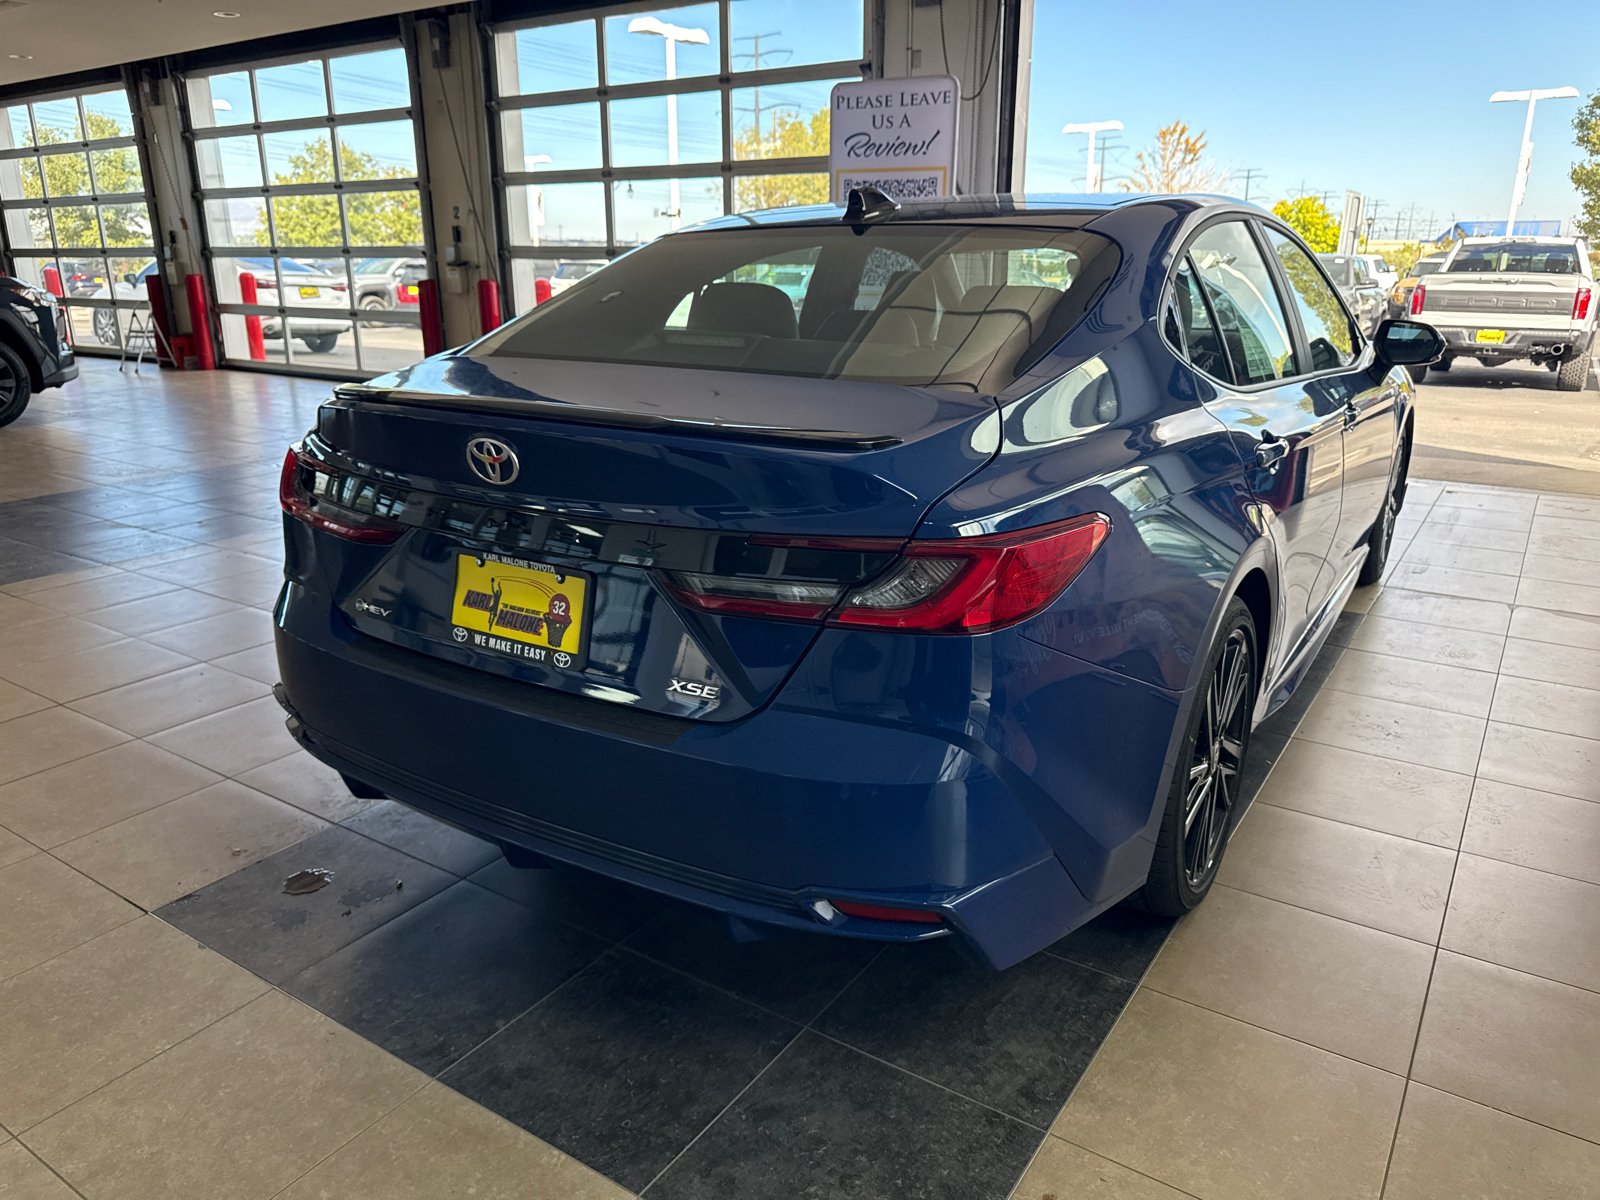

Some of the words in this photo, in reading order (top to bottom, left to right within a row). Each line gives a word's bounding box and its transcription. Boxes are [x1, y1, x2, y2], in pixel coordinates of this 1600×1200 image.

[836, 94, 893, 110] PLEASE
[900, 90, 951, 107] LEAVE
[872, 114, 894, 129] US
[899, 113, 911, 128] A
[844, 130, 940, 158] Review!
[453, 206, 460, 219] 2
[483, 552, 500, 563] KARL
[501, 556, 529, 568] MALONE
[529, 561, 556, 573] TOYOTA
[362, 602, 392, 617] HEV
[462, 589, 494, 612] KARL
[552, 600, 566, 616] 32
[495, 609, 544, 636] MALONE
[474, 633, 486, 646] WE
[488, 637, 511, 652] MAKE
[513, 643, 522, 653] IT
[524, 646, 546, 661] EASY
[666, 679, 720, 699] XSE
